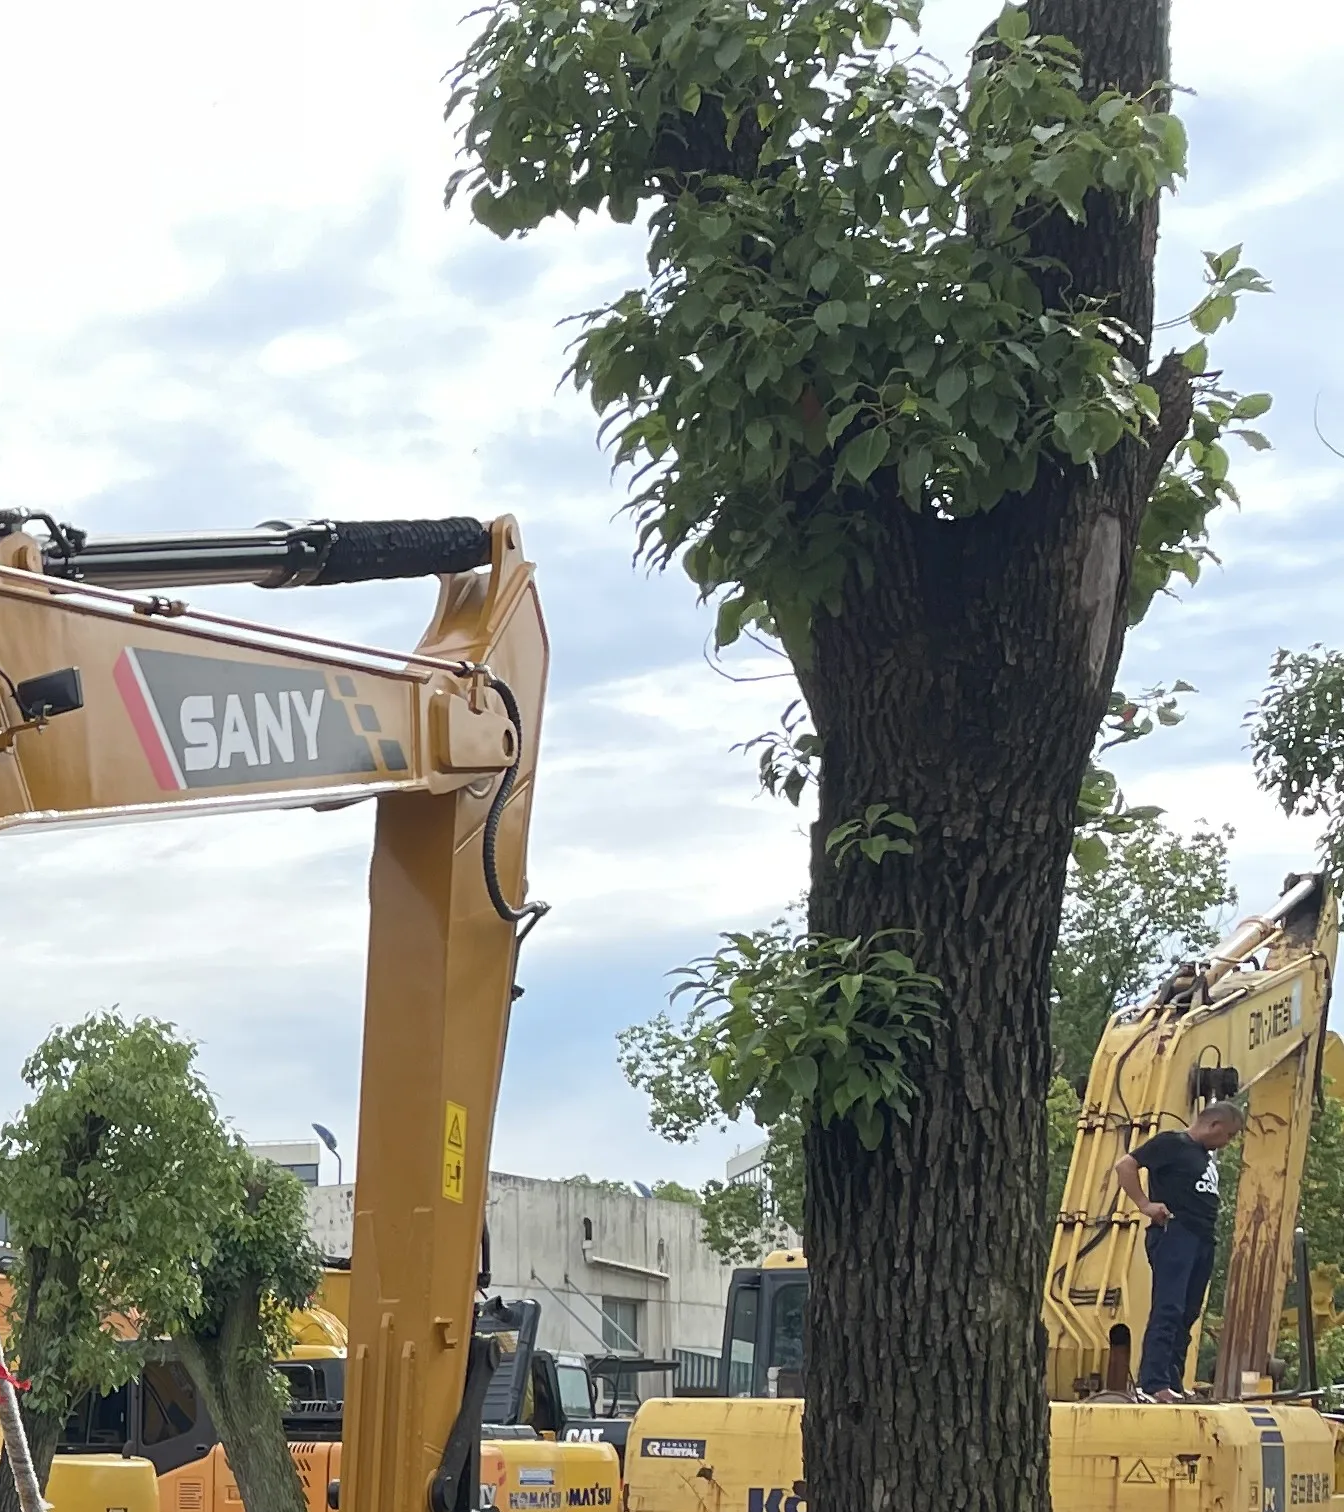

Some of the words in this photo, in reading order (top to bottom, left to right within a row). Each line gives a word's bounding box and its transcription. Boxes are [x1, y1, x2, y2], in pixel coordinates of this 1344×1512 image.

[179, 688, 325, 772] SANY
[566, 1428, 604, 1442] CAT
[662, 1448, 700, 1458] RENTAL
[565, 1483, 612, 1506] MATSU
